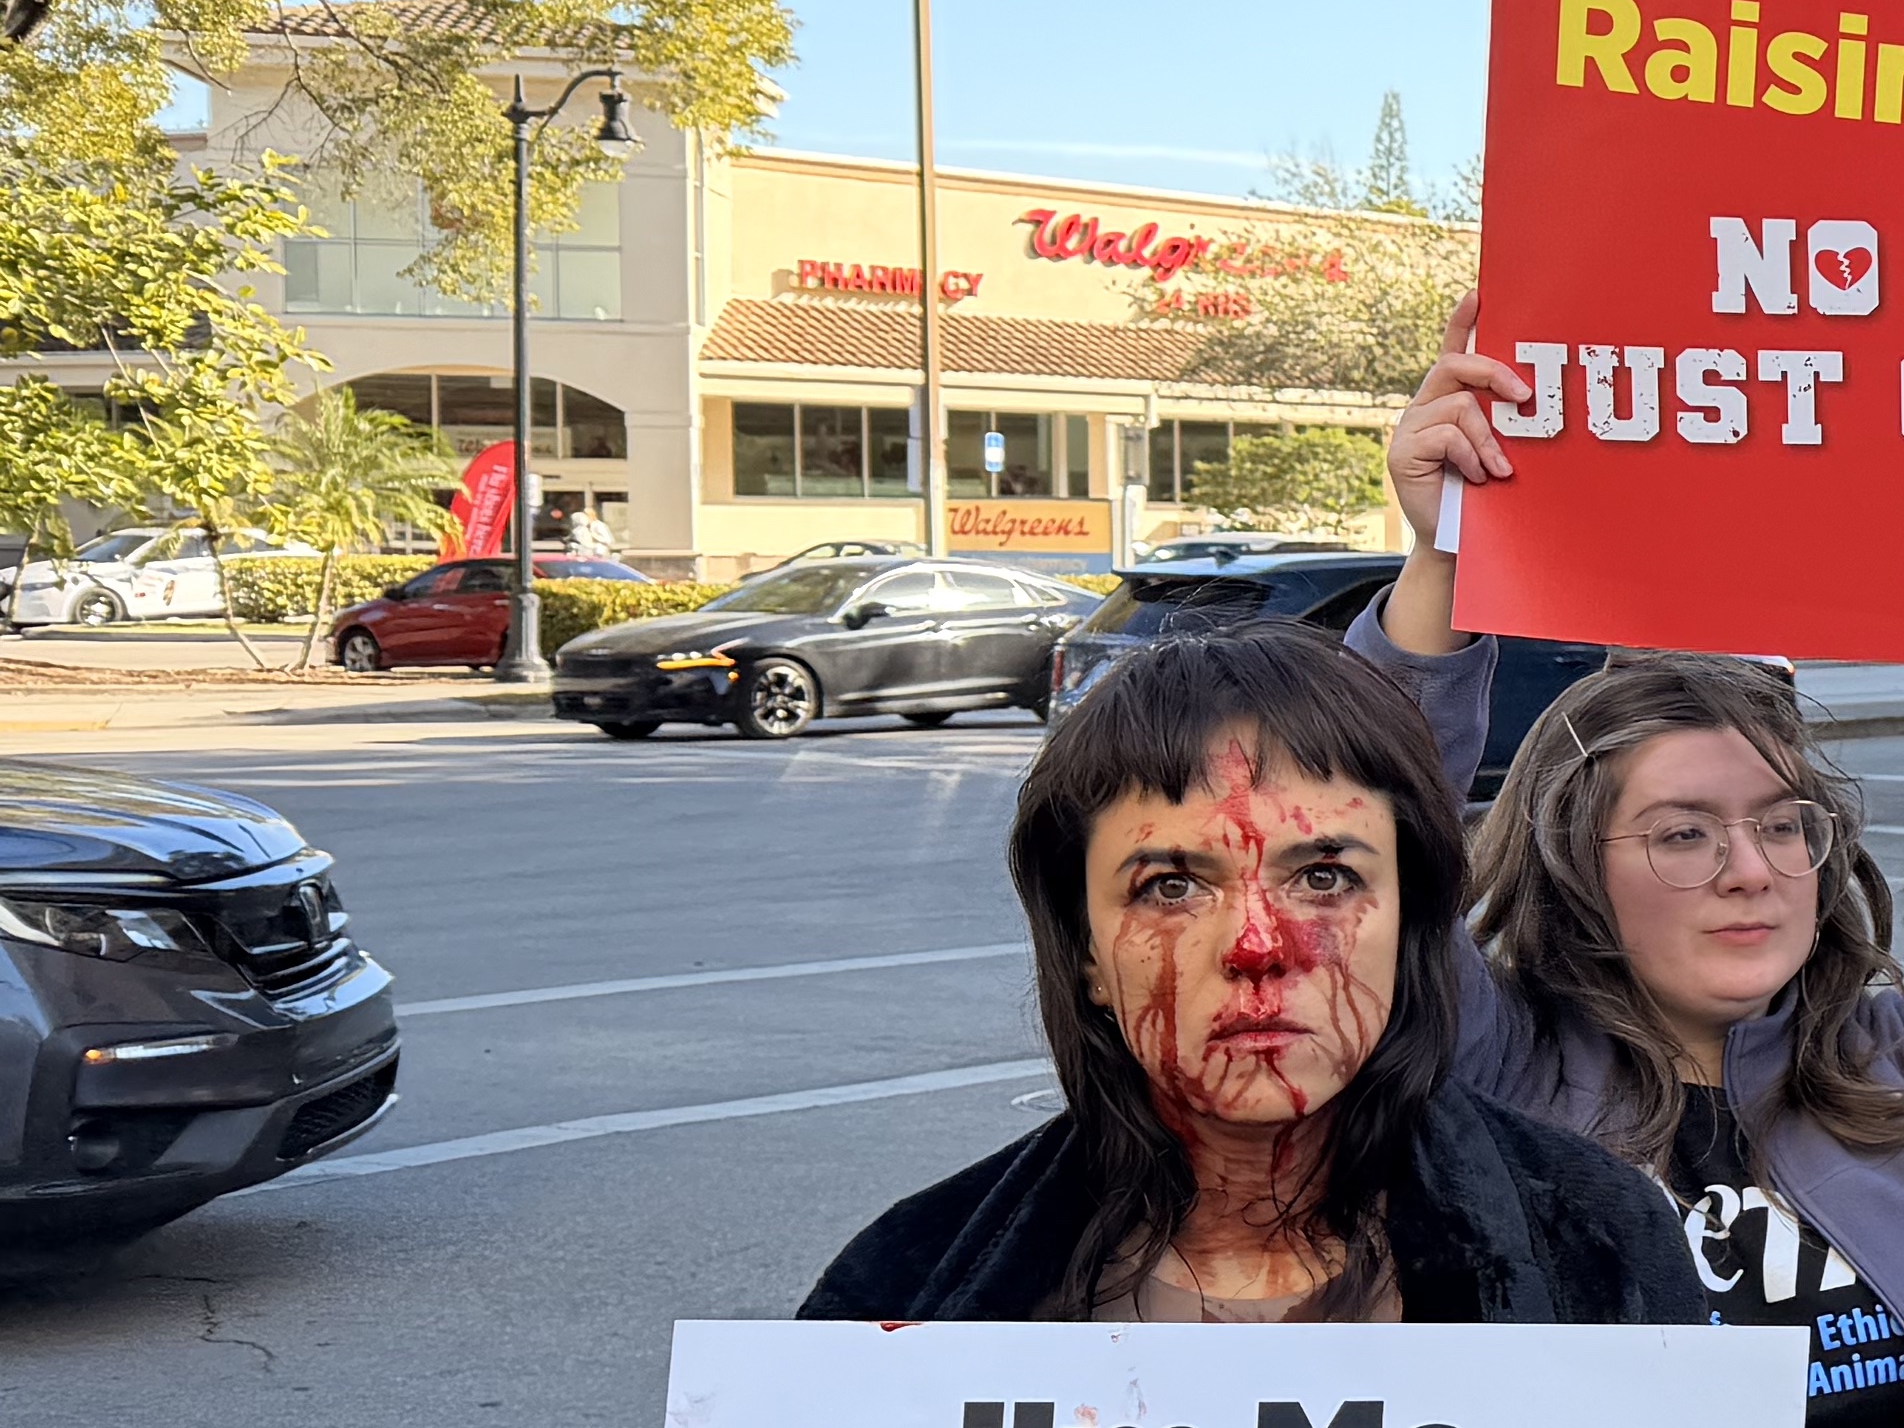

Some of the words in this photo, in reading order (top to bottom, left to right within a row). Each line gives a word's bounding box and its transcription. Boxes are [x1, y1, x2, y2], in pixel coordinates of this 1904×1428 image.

[798, 259, 983, 299] PHARMCY
[1710, 217, 1879, 315] NO
[1492, 342, 1843, 444] JUST
[948, 505, 1090, 546] Walgreens
